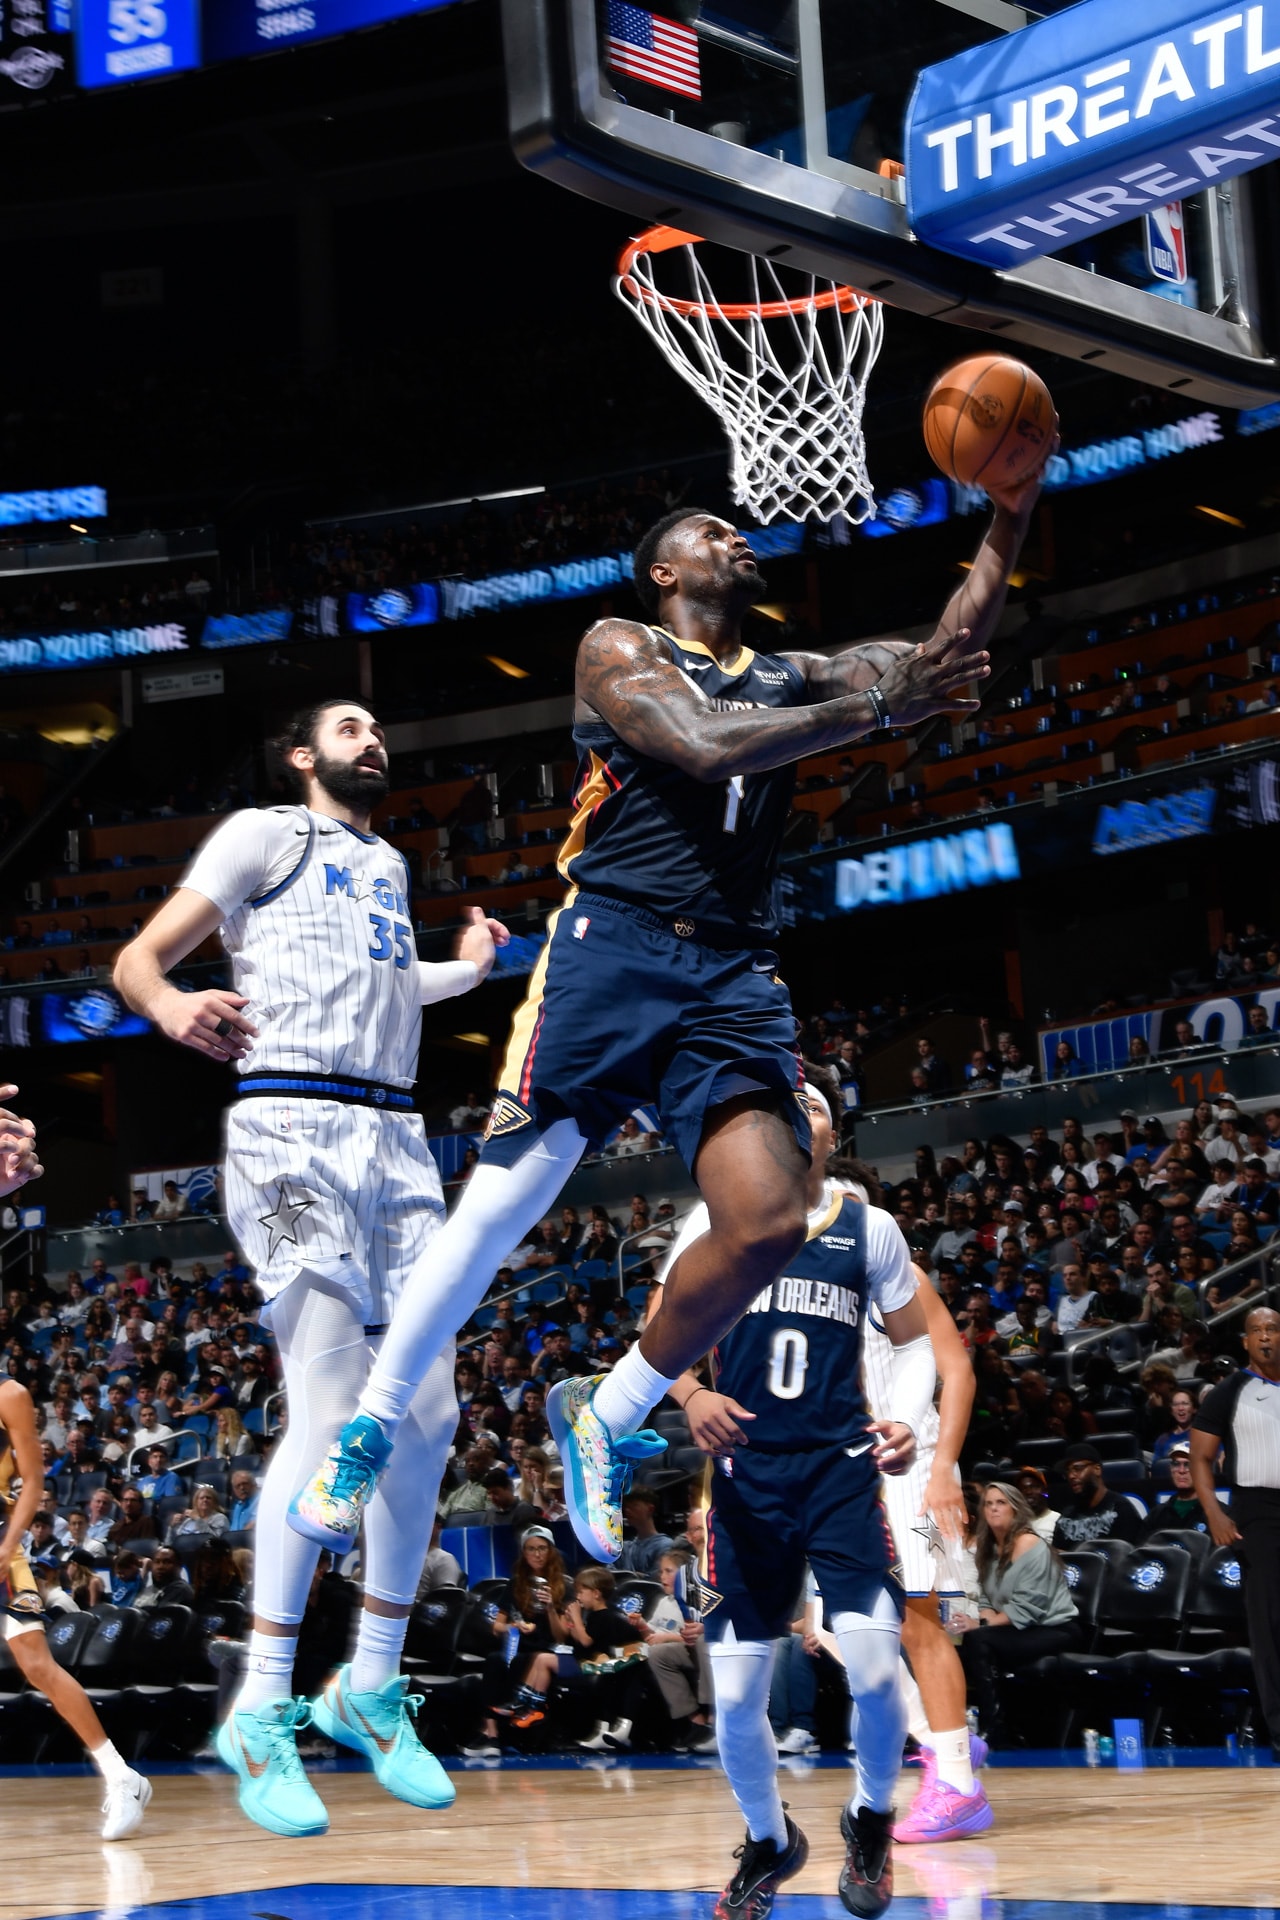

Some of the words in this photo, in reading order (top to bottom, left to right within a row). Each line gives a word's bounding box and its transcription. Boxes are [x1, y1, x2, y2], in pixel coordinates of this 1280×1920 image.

[927, 5, 1280, 193] THREATL
[968, 112, 1280, 250] THREAT
[1153, 246, 1174, 272] NBA
[722, 775, 745, 835] 1
[369, 913, 411, 970] 35
[1171, 1068, 1228, 1105] 114
[820, 1235, 856, 1247] NEWAGE
[776, 1276, 860, 1328] ORLEANS
[769, 1328, 809, 1400] 0
